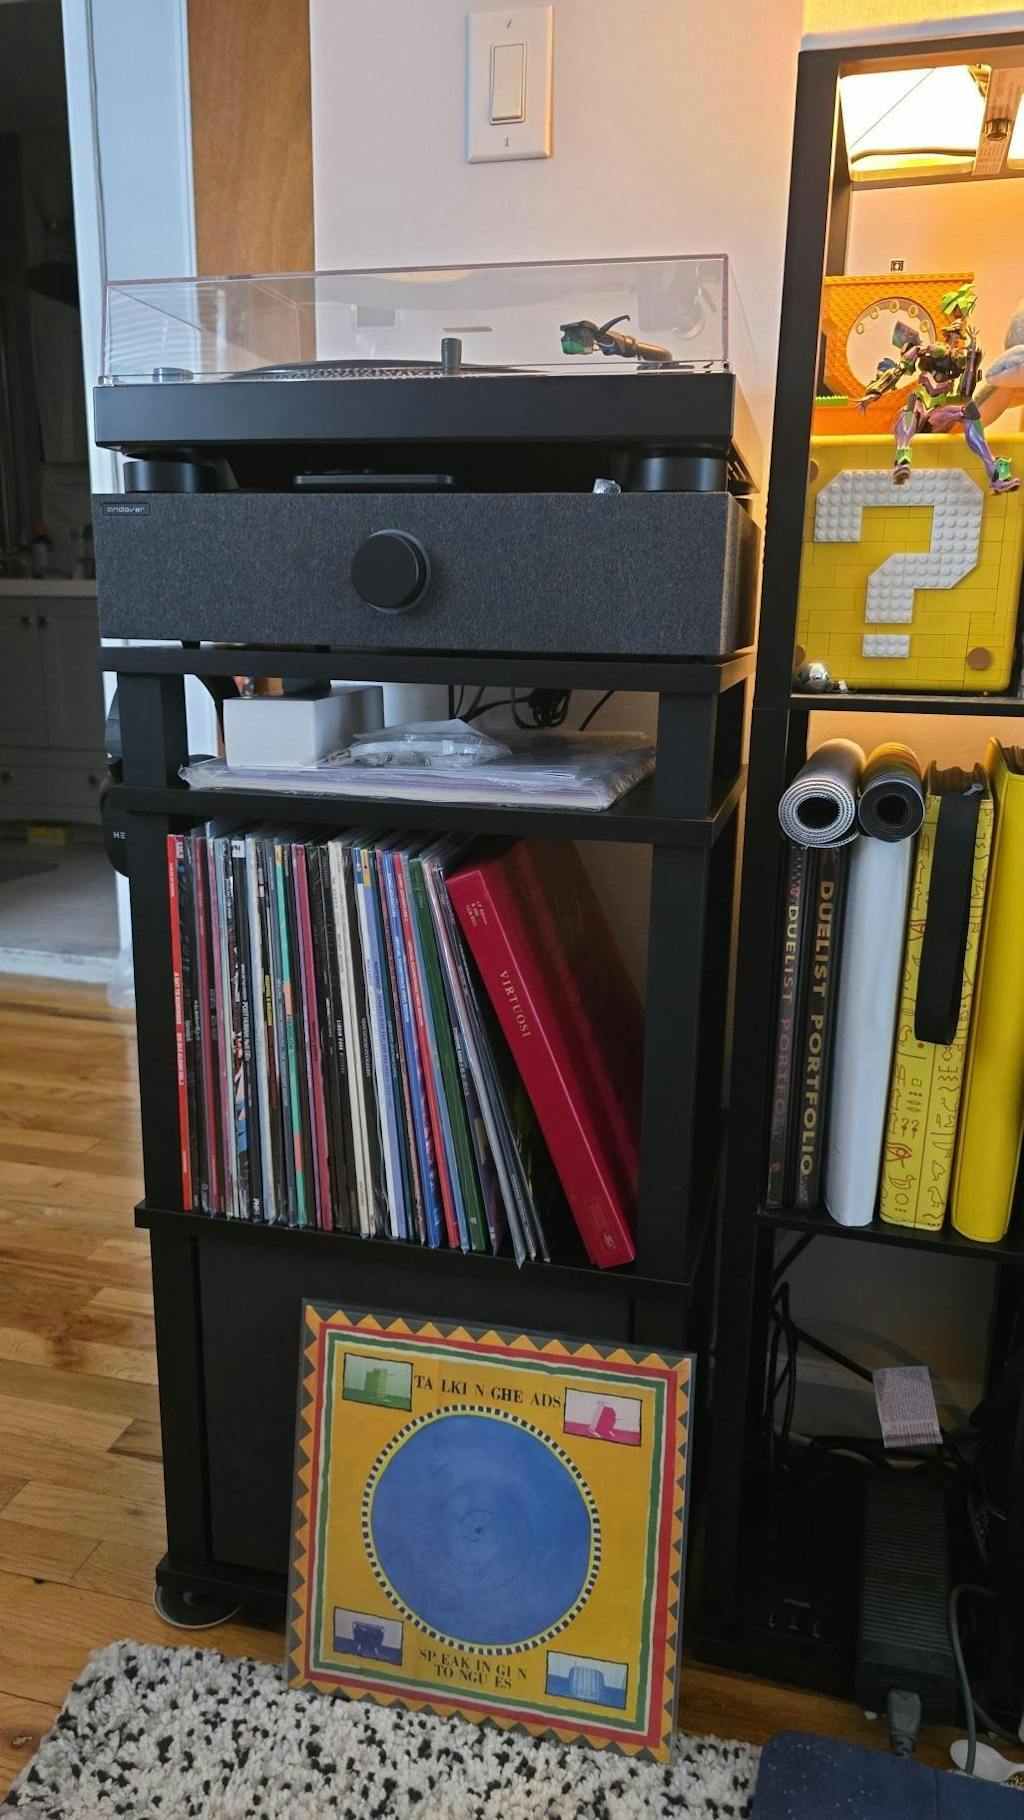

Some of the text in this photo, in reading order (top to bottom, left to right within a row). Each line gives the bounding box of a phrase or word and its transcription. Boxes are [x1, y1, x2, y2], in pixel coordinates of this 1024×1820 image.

[499, 969, 532, 1038] VIRTUOSI
[771, 905, 799, 1148] DUELIST PORTFOL
[800, 880, 834, 1176] DUELIST PORTFOLIO
